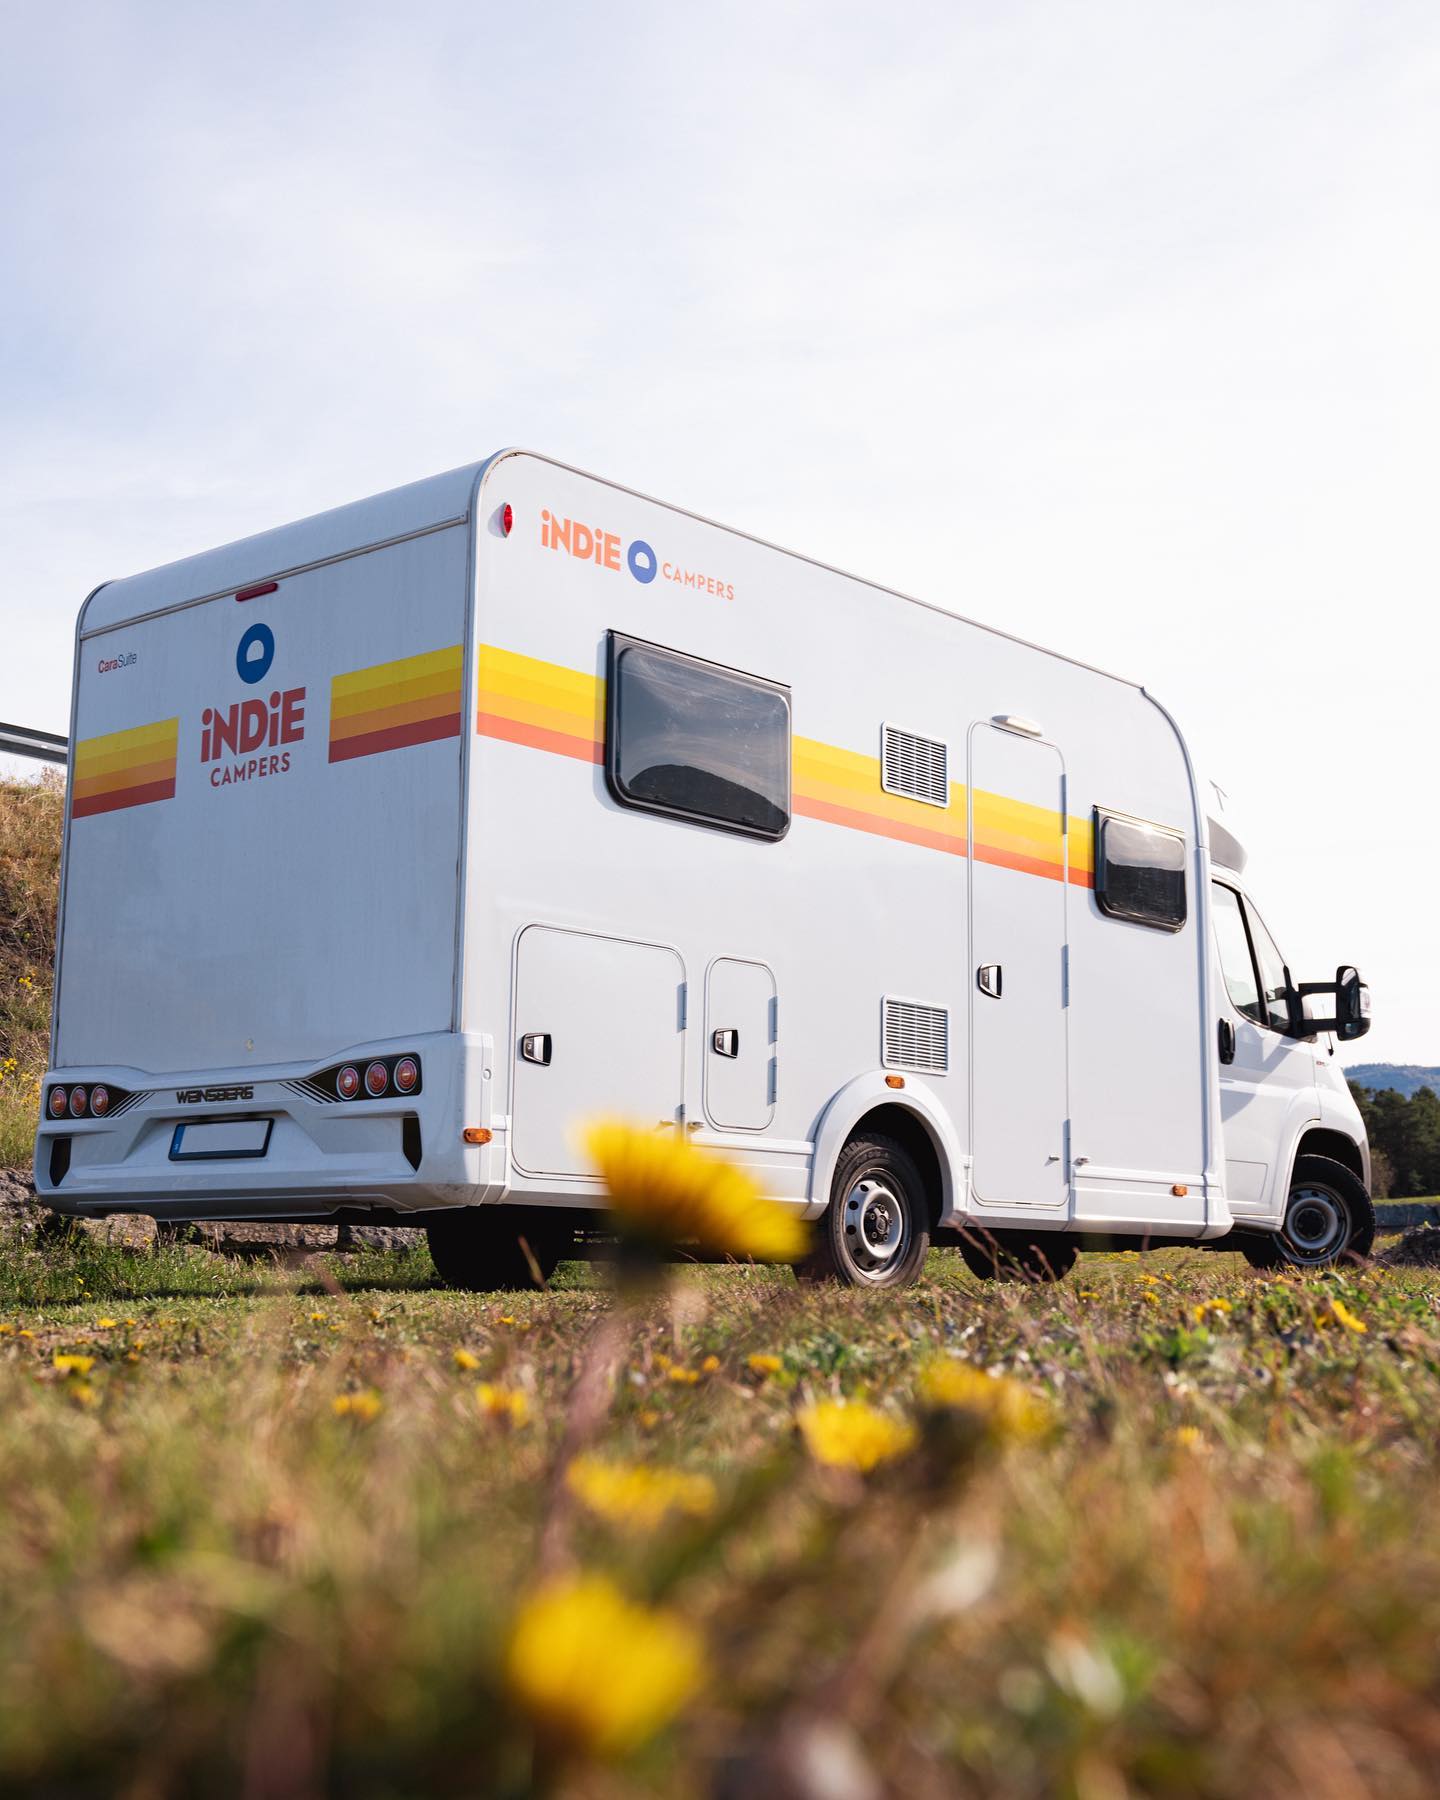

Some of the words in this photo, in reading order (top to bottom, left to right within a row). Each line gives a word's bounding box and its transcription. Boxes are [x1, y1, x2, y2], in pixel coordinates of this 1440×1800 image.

[662, 562, 735, 601] CAMPERS
[98, 652, 137, 674] CaraSuite
[210, 752, 291, 788] CAMPERS
